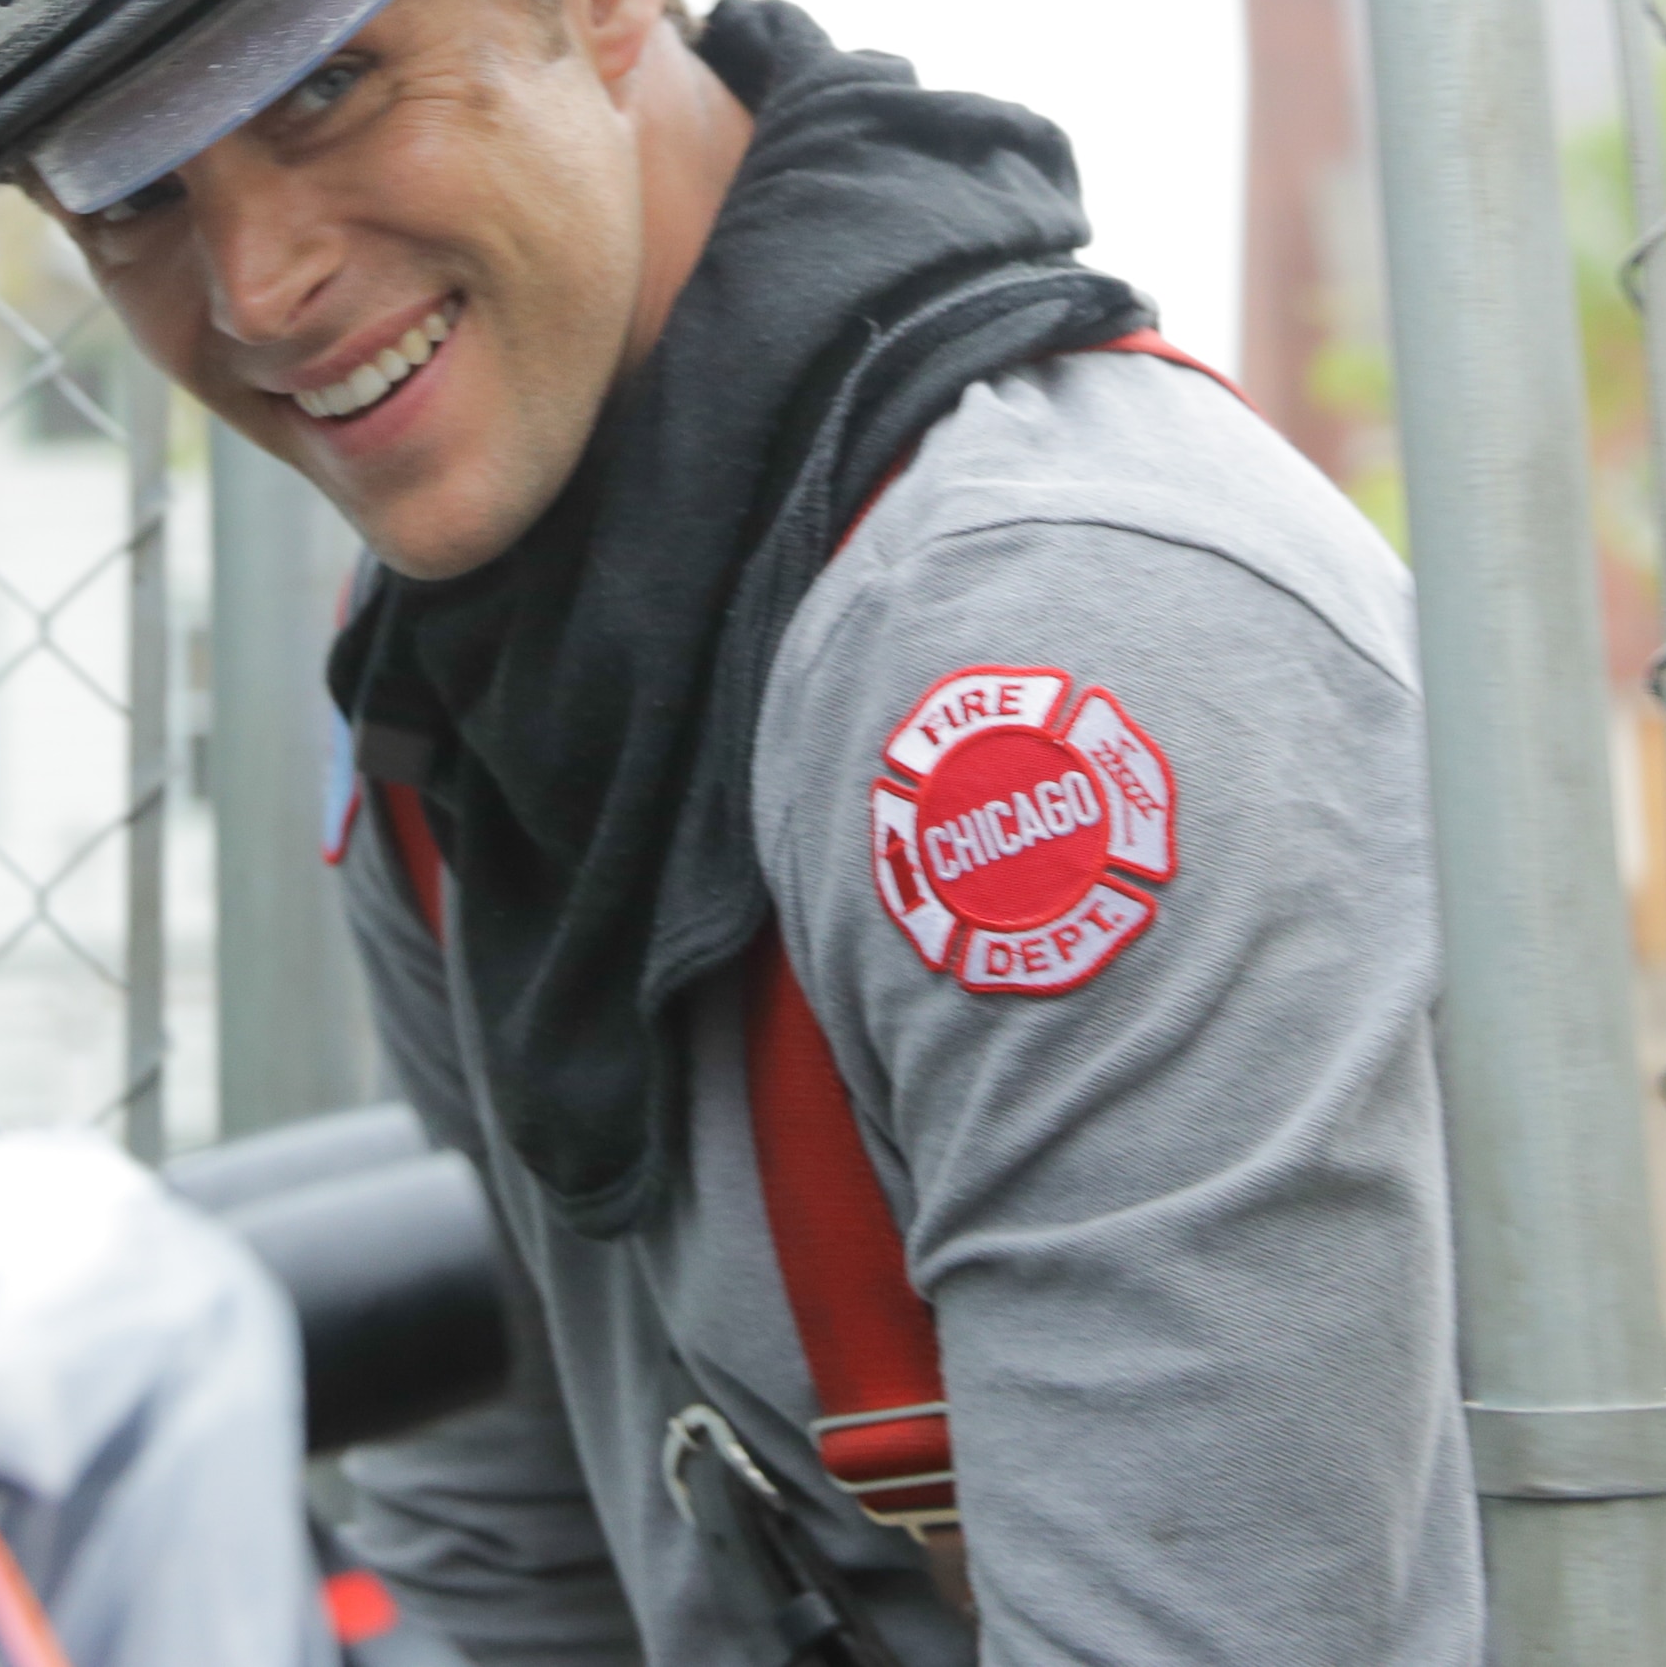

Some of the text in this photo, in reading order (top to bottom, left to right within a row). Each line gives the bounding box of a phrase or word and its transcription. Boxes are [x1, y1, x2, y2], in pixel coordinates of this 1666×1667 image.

[918, 684, 1027, 746] FIRE
[923, 770, 1102, 882] CHICAGO
[986, 900, 1126, 976] DEPT.
